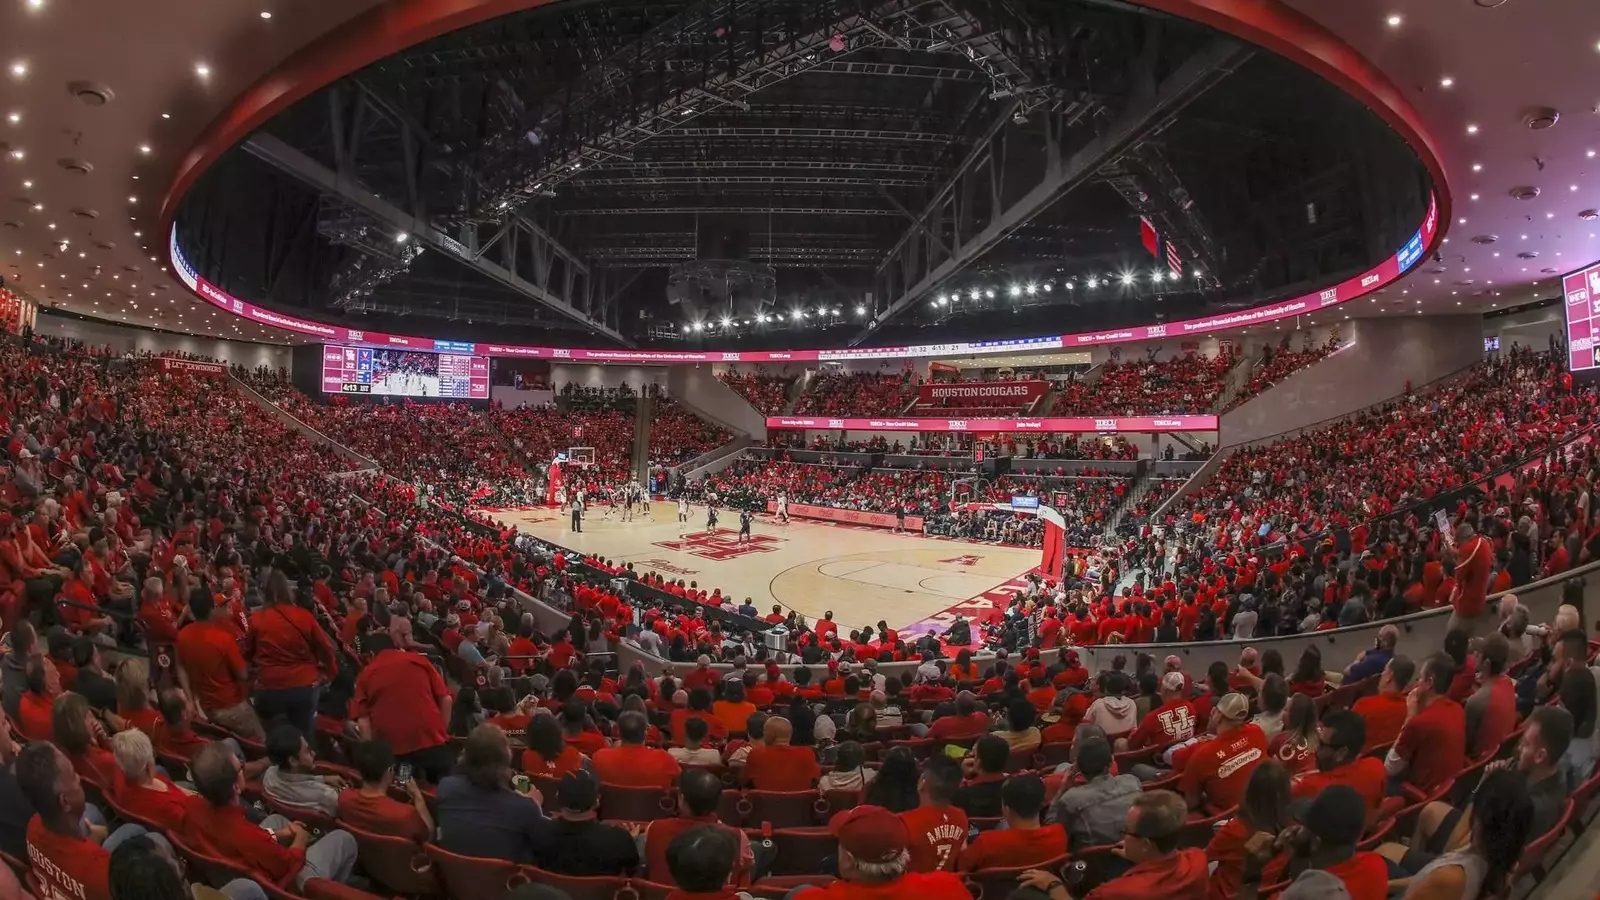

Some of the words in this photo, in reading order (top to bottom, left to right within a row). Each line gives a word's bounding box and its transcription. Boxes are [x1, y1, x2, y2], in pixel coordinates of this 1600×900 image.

[1192, 321, 1212, 330] preferred
[1212, 317, 1230, 326] financial
[1264, 306, 1284, 316] University
[1288, 302, 1306, 311] Houston
[1147, 325, 1166, 334] TDECU
[932, 387, 980, 397] HOUSTON
[979, 385, 1028, 396] COUGARS
[926, 824, 964, 845] ANTHONY
[936, 844, 952, 870] 7
[27, 840, 86, 900] OUSTON
